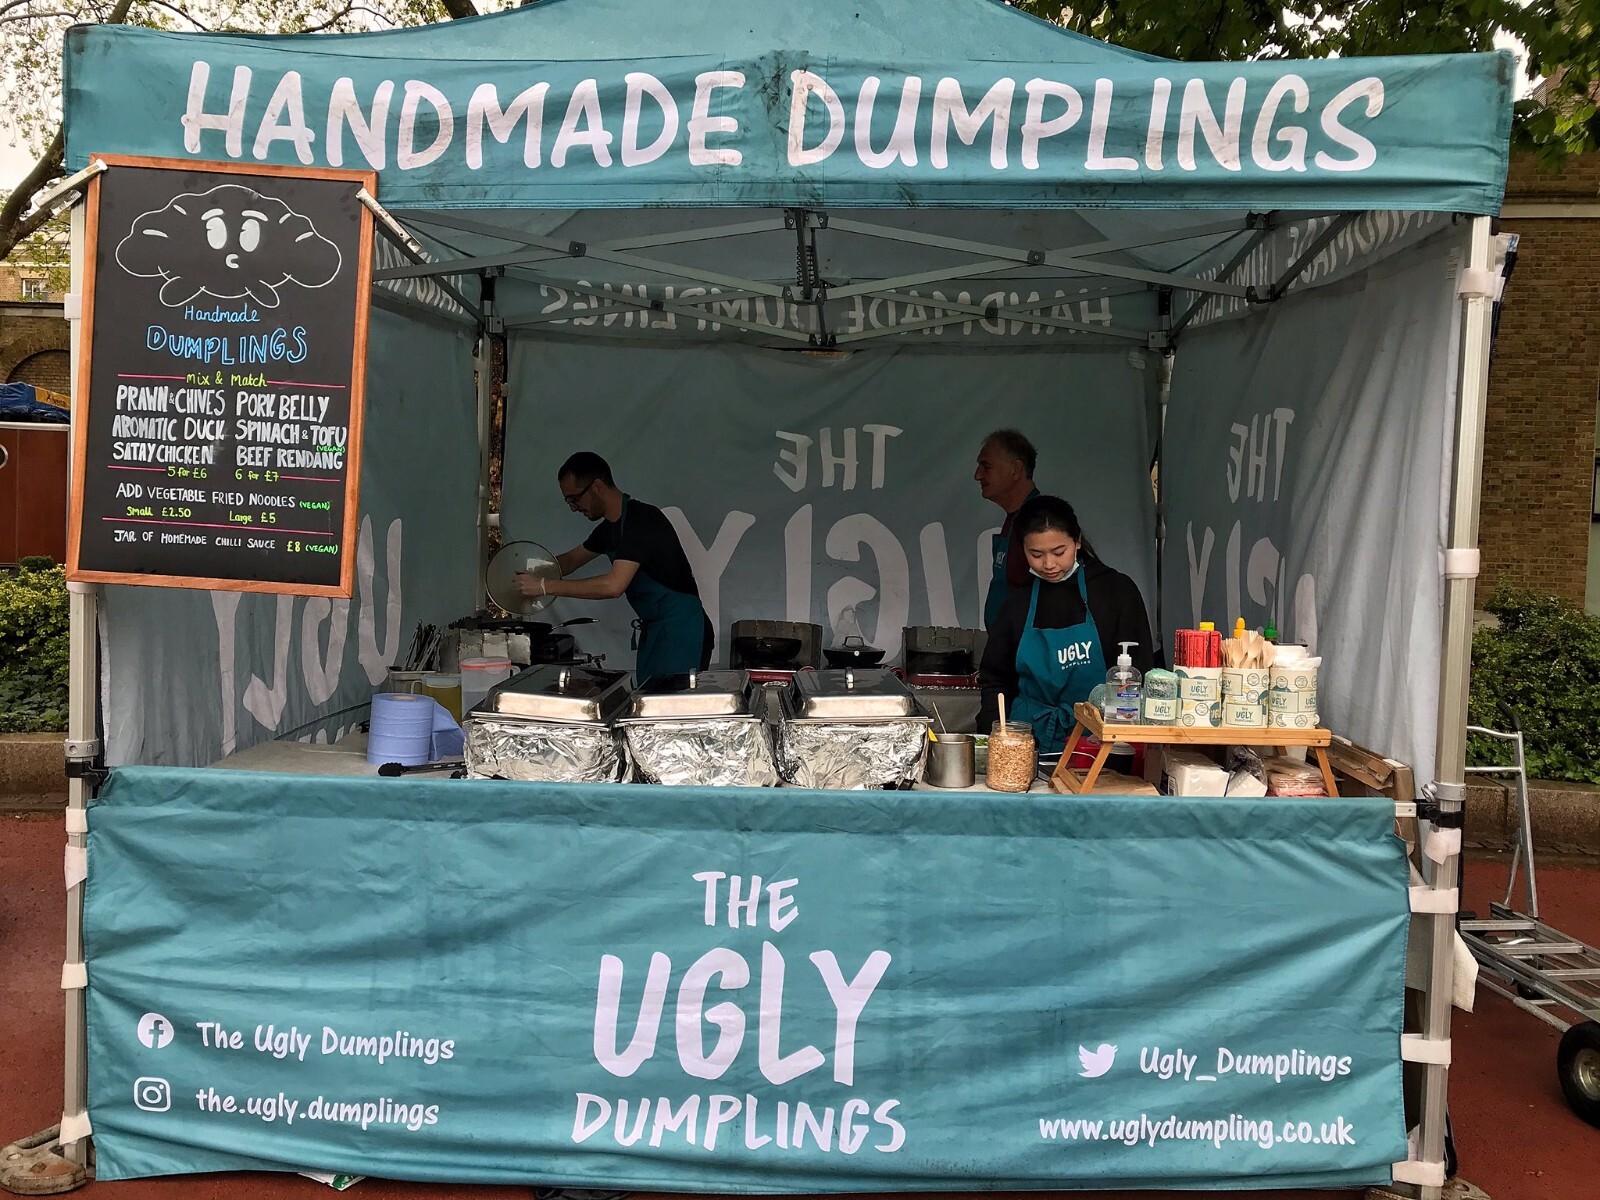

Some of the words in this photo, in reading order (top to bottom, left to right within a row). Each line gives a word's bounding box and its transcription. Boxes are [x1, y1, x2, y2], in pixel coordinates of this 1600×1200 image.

[180, 61, 746, 170] HANDMADE
[787, 69, 1385, 172] DUMPLINGS
[184, 303, 260, 323] Handmade
[147, 325, 307, 365] DUMPLINGS
[215, 370, 223, 385] &
[230, 372, 267, 387] Match
[116, 384, 169, 412] PRAWN
[175, 388, 226, 416] CHIVES
[236, 391, 276, 418] PORK
[279, 395, 330, 424] BELLY
[112, 414, 177, 442] AROMATIC
[184, 417, 225, 441] DUCK
[235, 419, 300, 445] SPINACH
[301, 429, 309, 440] &
[310, 425, 347, 447] TOFU
[113, 441, 157, 463] SATAY
[156, 444, 214, 465] CHICKEN
[236, 445, 273, 468] BEEF
[277, 448, 343, 470] RENDANG
[316, 445, 346, 453] (VEGAN)
[167, 467, 176, 478] 5
[176, 467, 190, 478] for
[192, 469, 208, 480] £6
[235, 470, 243, 481] 6
[248, 470, 260, 481] for
[264, 471, 279, 482] £7
[115, 482, 142, 499] ADD
[147, 486, 206, 503] VEGETABLE
[212, 491, 244, 506] FRIED
[249, 493, 296, 508] NOODLES
[299, 501, 331, 511] (VEGAN)
[126, 506, 153, 517] Small
[161, 506, 192, 518] £2.50
[229, 510, 253, 523] Large
[260, 512, 276, 524] £5
[113, 530, 136, 542] JAR
[142, 531, 154, 542] OF
[161, 533, 207, 545] HOMEMADE
[215, 537, 241, 547] CHILLI
[247, 538, 276, 549] SAUCE
[287, 541, 301, 553] £8
[305, 544, 338, 554] (VEGAN)
[1058, 640, 1092, 664] UGLY
[1191, 685, 1208, 694] UGLY
[1155, 705, 1171, 714] UGLY
[1235, 711, 1253, 719] UGLY
[692, 871, 799, 932] THE
[593, 940, 892, 1087] UGLY
[196, 1022, 244, 1050] The
[254, 1024, 311, 1061] Ugly
[321, 1026, 455, 1065] Dumplings
[1140, 1047, 1352, 1083] Ugly_Dumplings
[196, 1087, 439, 1131] the.ugly.dumplings
[571, 1093, 906, 1155] DUMPLINGS
[1039, 1113, 1356, 1149] www.uglydumpling.co.uk
